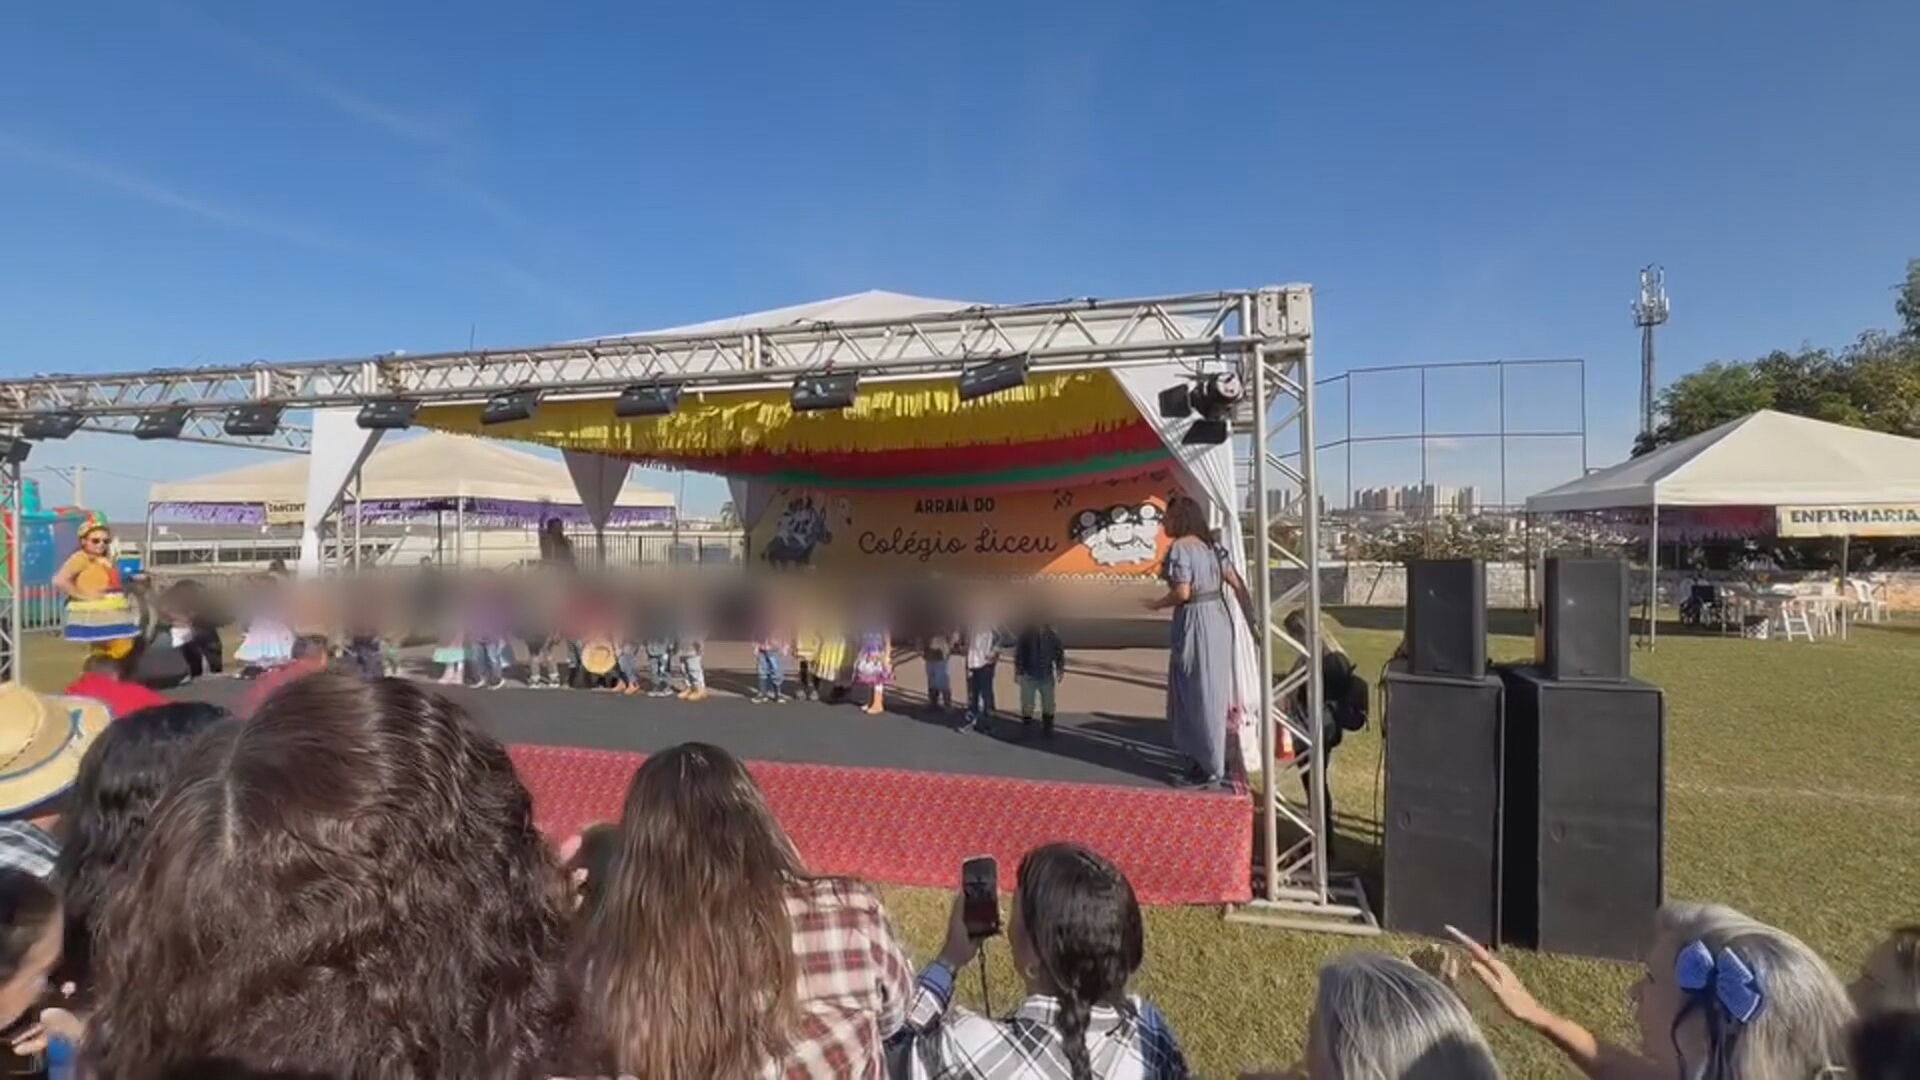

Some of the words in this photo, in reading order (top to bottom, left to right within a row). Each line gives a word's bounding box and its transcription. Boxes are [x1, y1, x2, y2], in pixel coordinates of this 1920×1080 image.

[973, 497, 996, 512] DO
[1790, 509, 1920, 522] ENFERMARIA
[858, 527, 966, 562] Colégio
[974, 528, 1058, 553] Liceu
